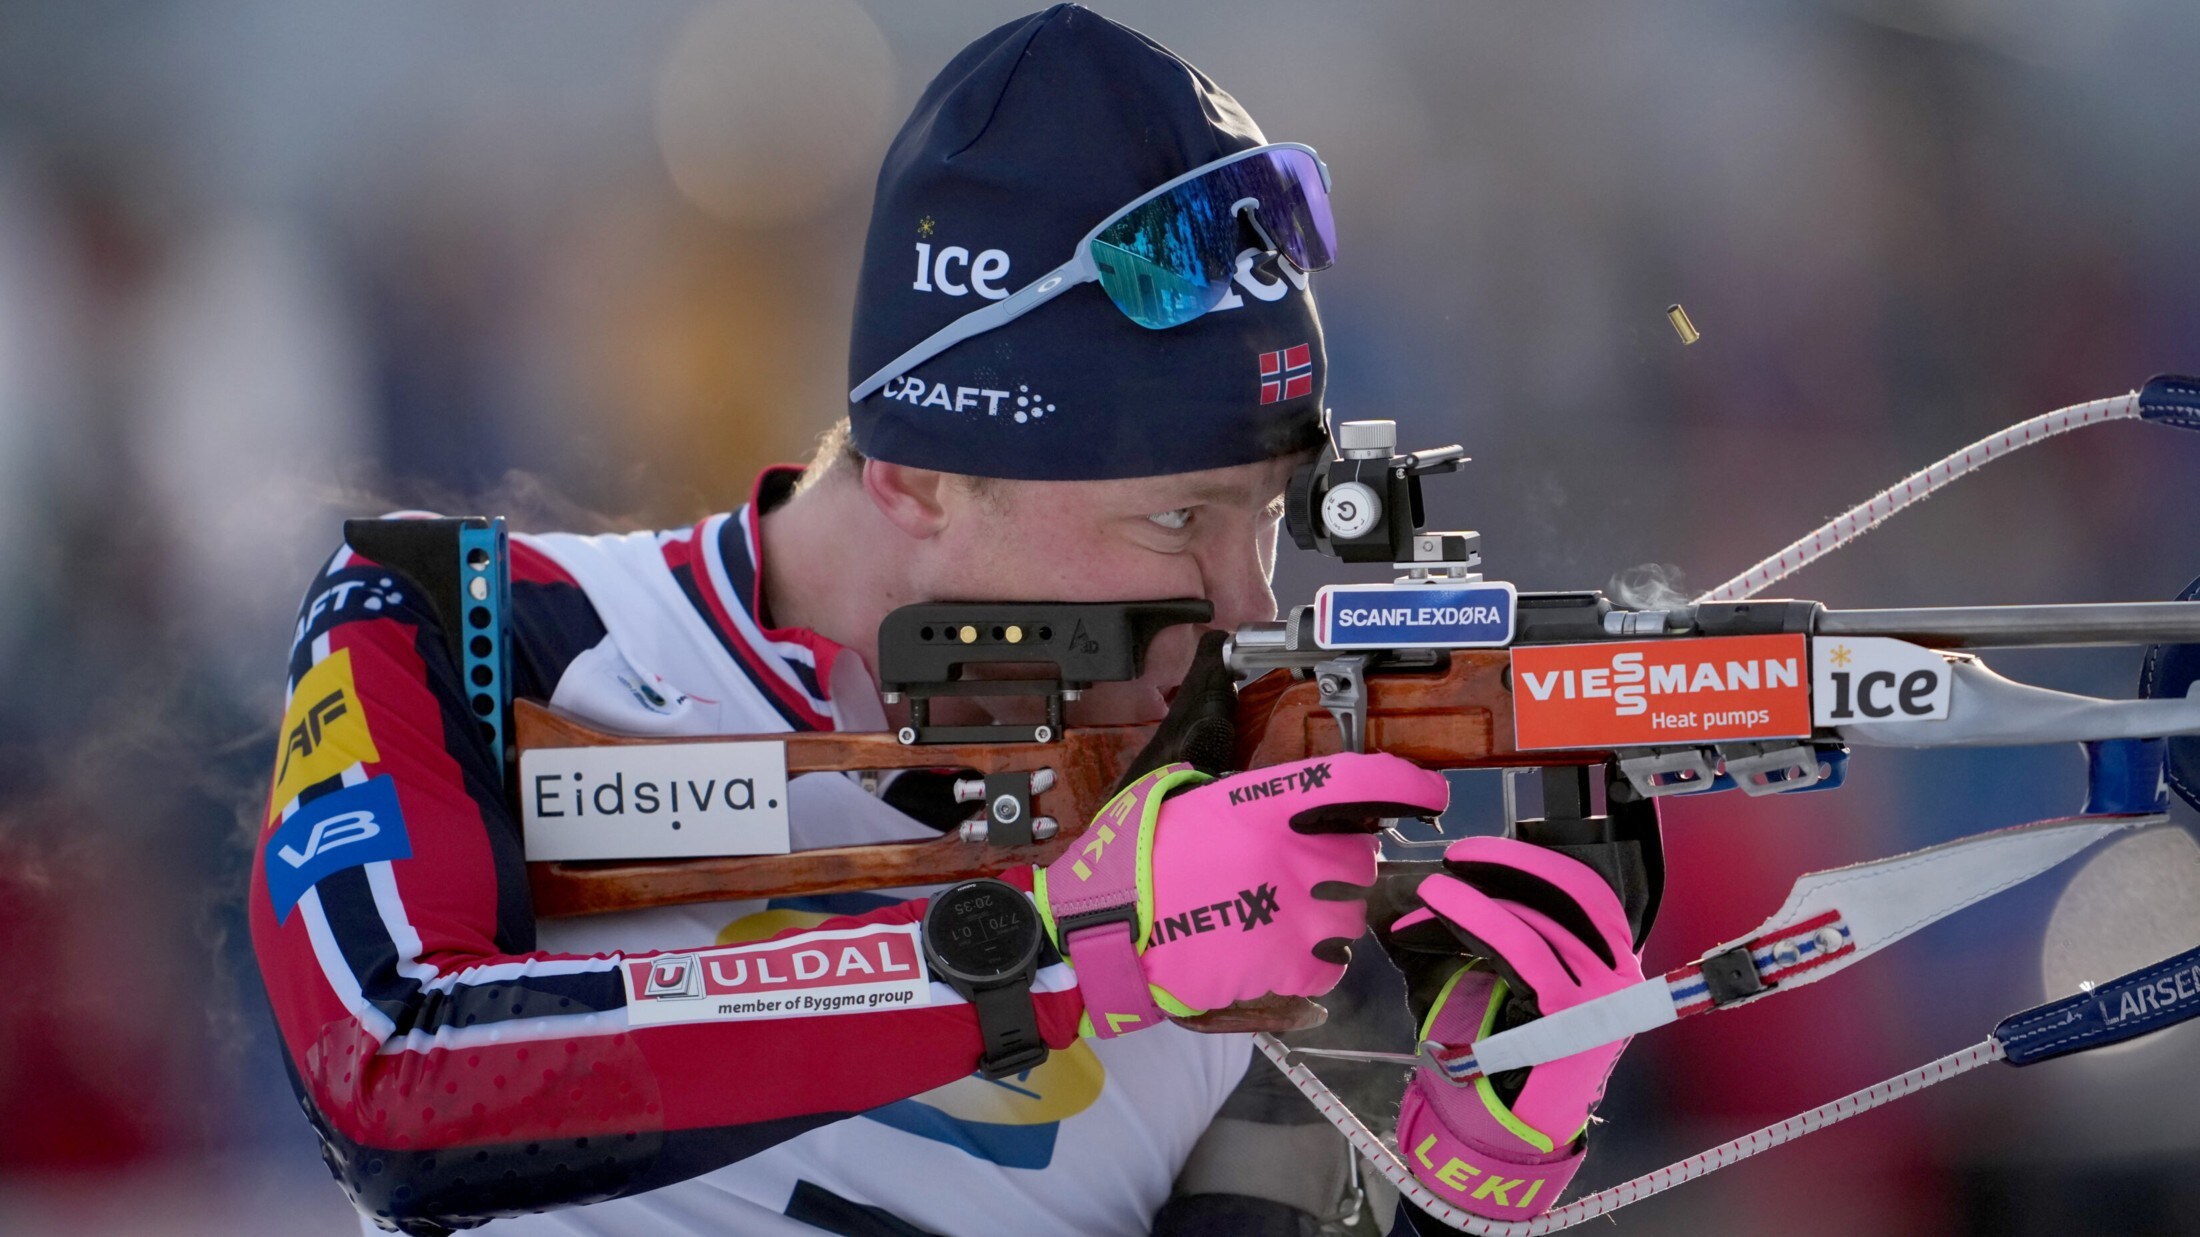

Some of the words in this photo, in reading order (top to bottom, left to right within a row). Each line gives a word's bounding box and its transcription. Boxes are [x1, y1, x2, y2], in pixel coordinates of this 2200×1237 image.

[913, 216, 1010, 300] ice
[883, 375, 1010, 416] CRAFT
[1521, 652, 1798, 716] VIESSMANN
[1830, 645, 1939, 719] ice
[1651, 711, 1698, 730] Heat
[1703, 709, 1770, 731] pumps
[709, 941, 910, 987] ULDAL
[718, 998, 782, 1014] member
[784, 996, 802, 1010] of
[804, 994, 866, 1011] Byggma
[868, 990, 914, 1006] group
[1414, 1133, 1546, 1208] LEKI
